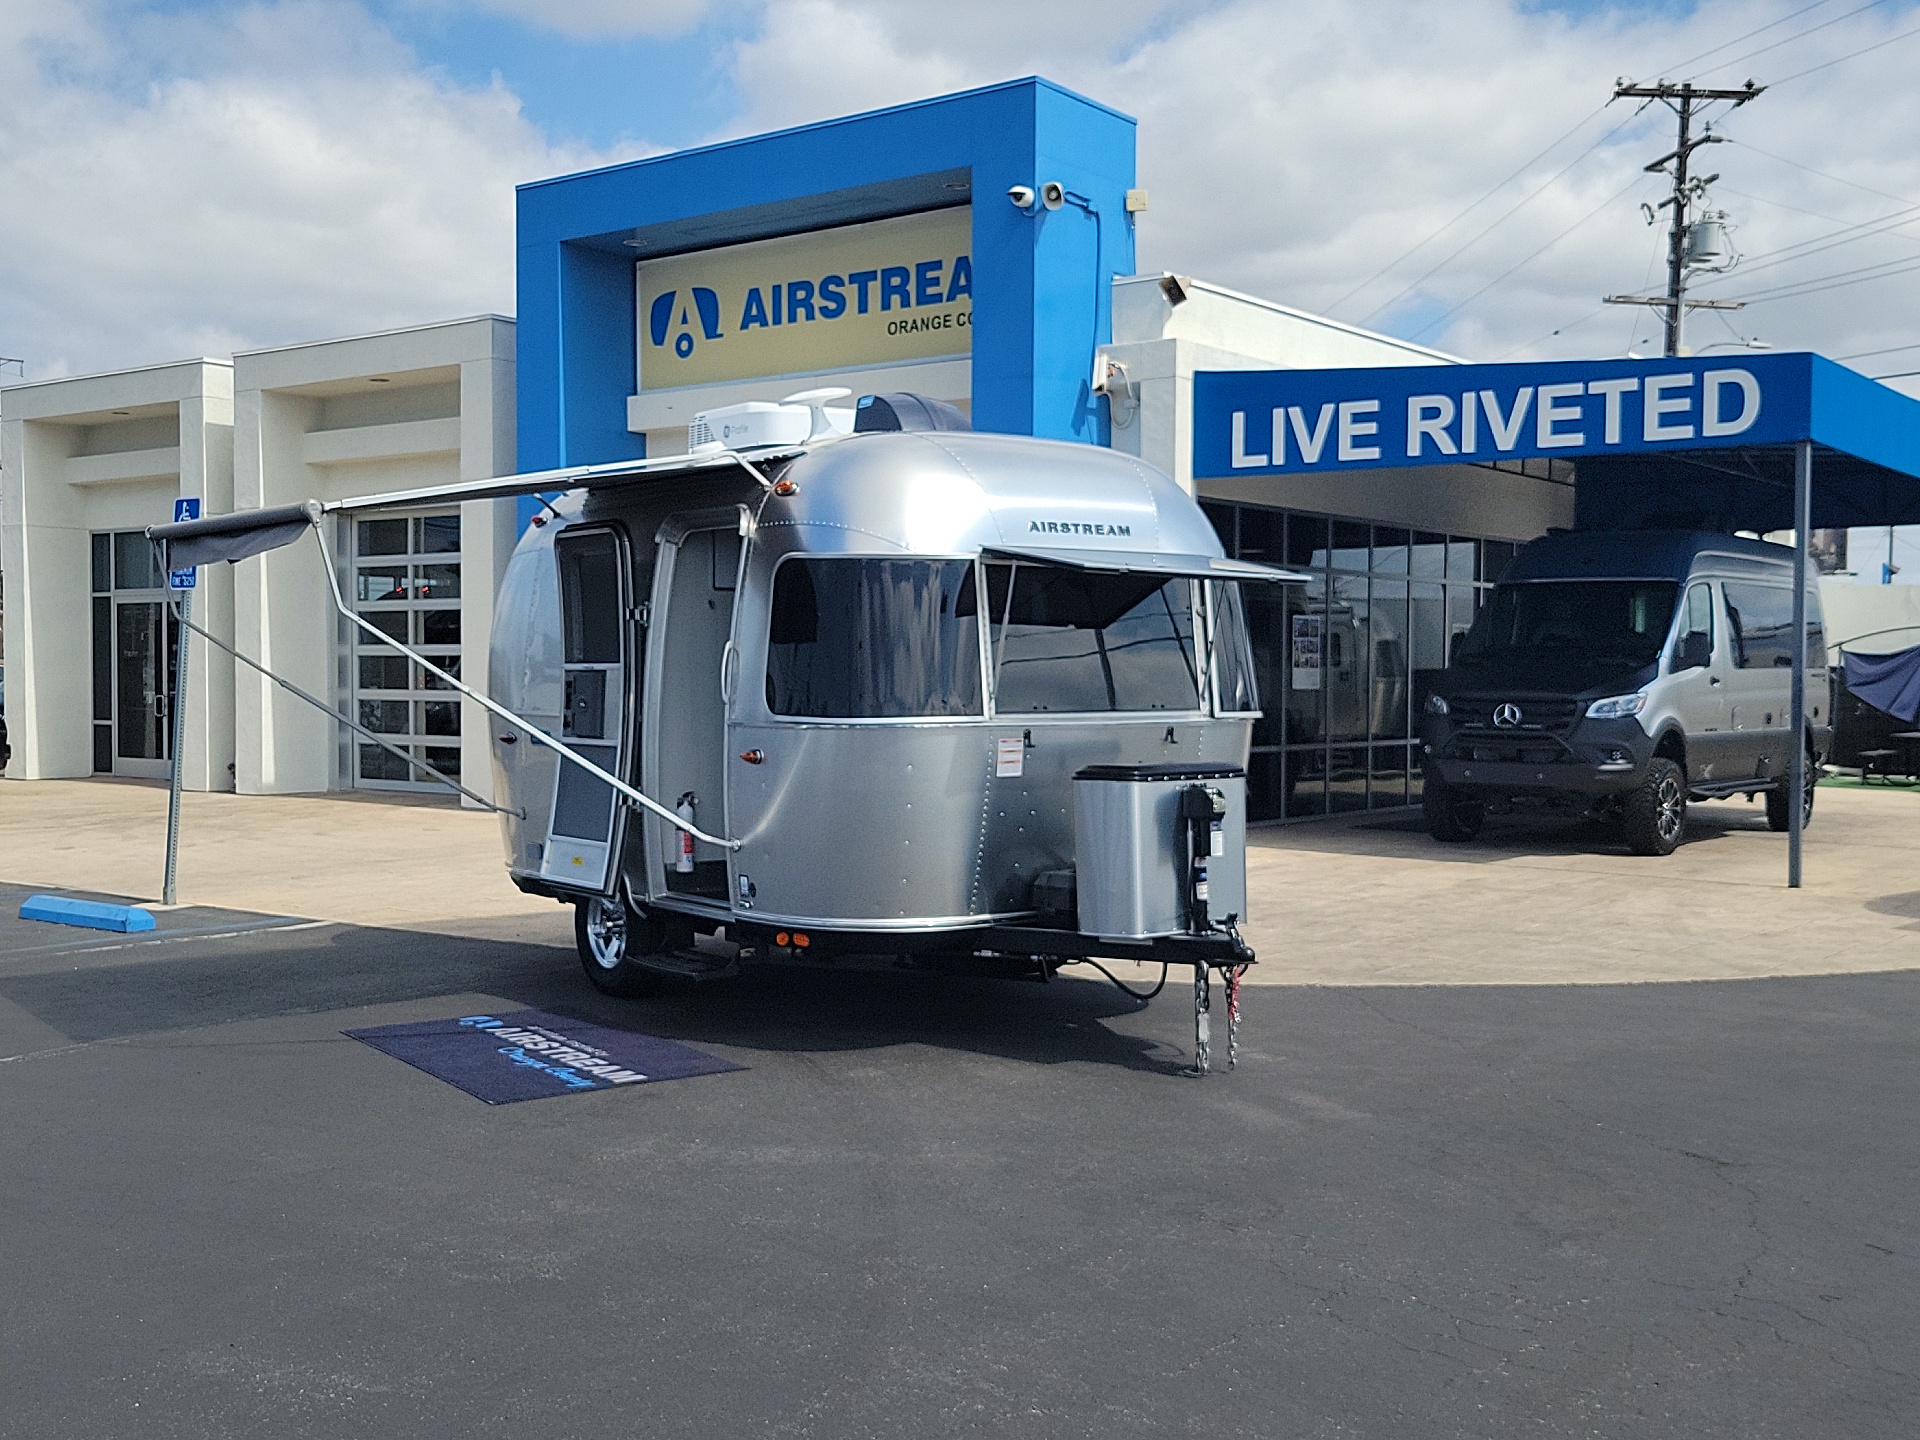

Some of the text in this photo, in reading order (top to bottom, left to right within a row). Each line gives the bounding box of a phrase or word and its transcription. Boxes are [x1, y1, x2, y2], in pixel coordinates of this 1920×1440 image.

[887, 313, 953, 336] ORANGE
[1231, 369, 1761, 469] LIVE RIVETED
[1029, 520, 1132, 537] AIRSTREAM
[485, 1027, 650, 1084] AIRSTREAM
